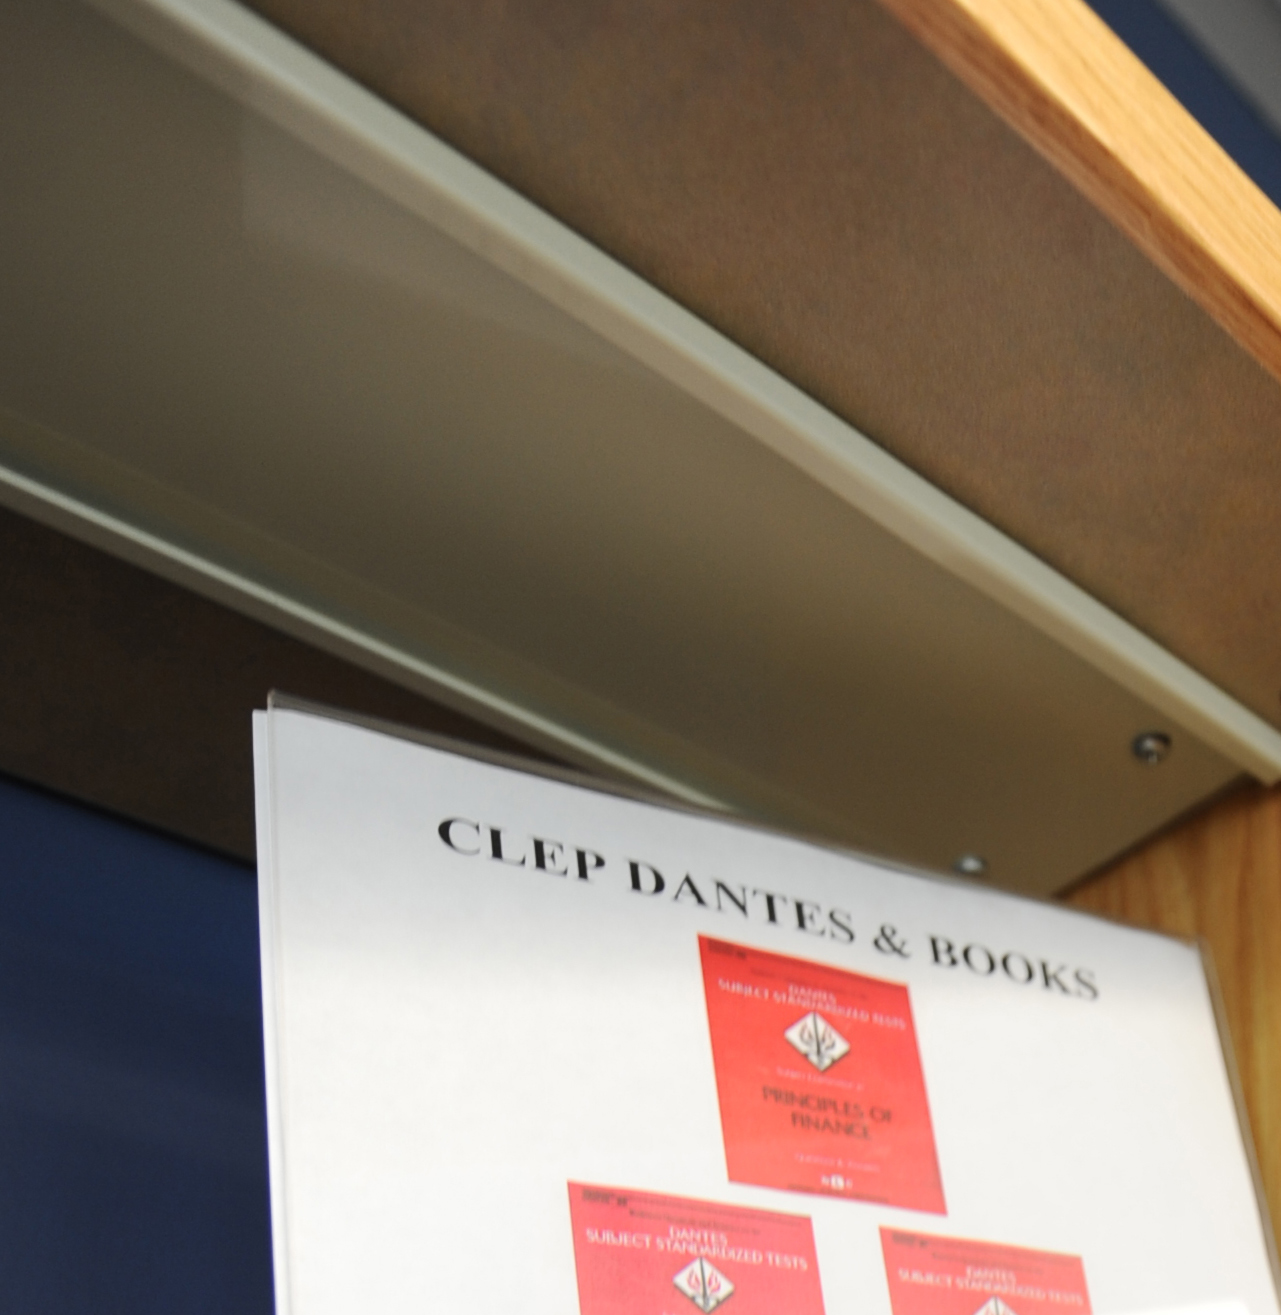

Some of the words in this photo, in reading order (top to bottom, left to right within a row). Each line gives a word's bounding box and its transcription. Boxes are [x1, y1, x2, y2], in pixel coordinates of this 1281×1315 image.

[438, 816, 606, 882] CLEP
[627, 860, 857, 944] DANTES
[871, 923, 912, 959] &
[927, 934, 1101, 1001] BOOKS
[586, 1228, 650, 1249] SUBJECT
[656, 1236, 763, 1264] STANDARDIZED
[766, 1252, 808, 1271] TESTS
[669, 1225, 727, 1247] DANTES
